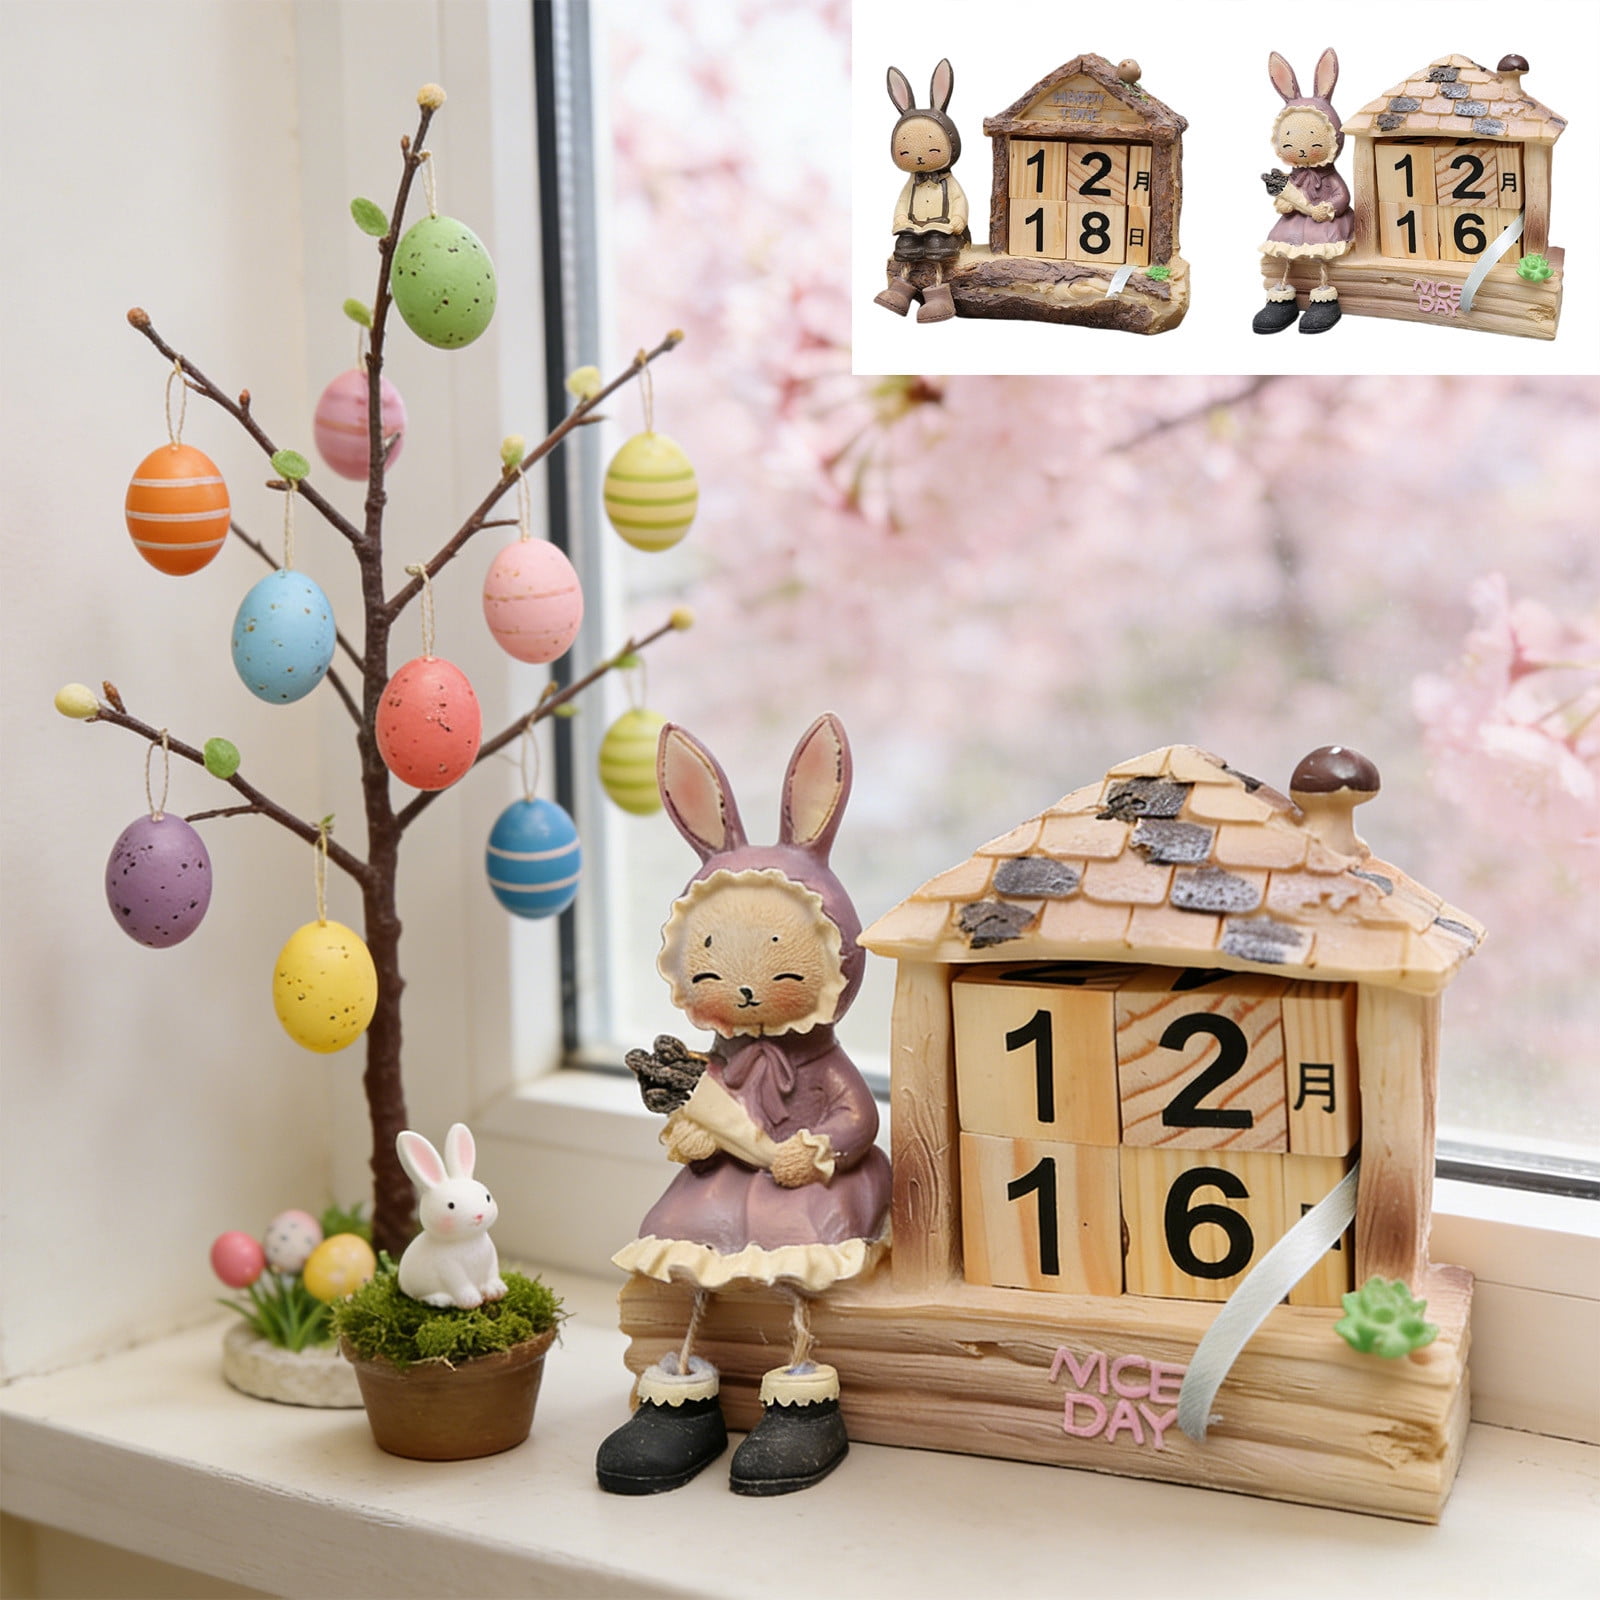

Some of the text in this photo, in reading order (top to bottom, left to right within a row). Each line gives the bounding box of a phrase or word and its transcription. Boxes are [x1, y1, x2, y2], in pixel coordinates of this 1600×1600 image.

[1133, 171, 1150, 192] 月
[1500, 172, 1517, 193] 月
[1129, 228, 1144, 247] 日
[1412, 279, 1464, 300] NICE
[1418, 295, 1460, 318] DAY
[1293, 1062, 1337, 1114] 月
[1049, 1345, 1187, 1404] NICE
[1063, 1391, 1178, 1450] DAY
